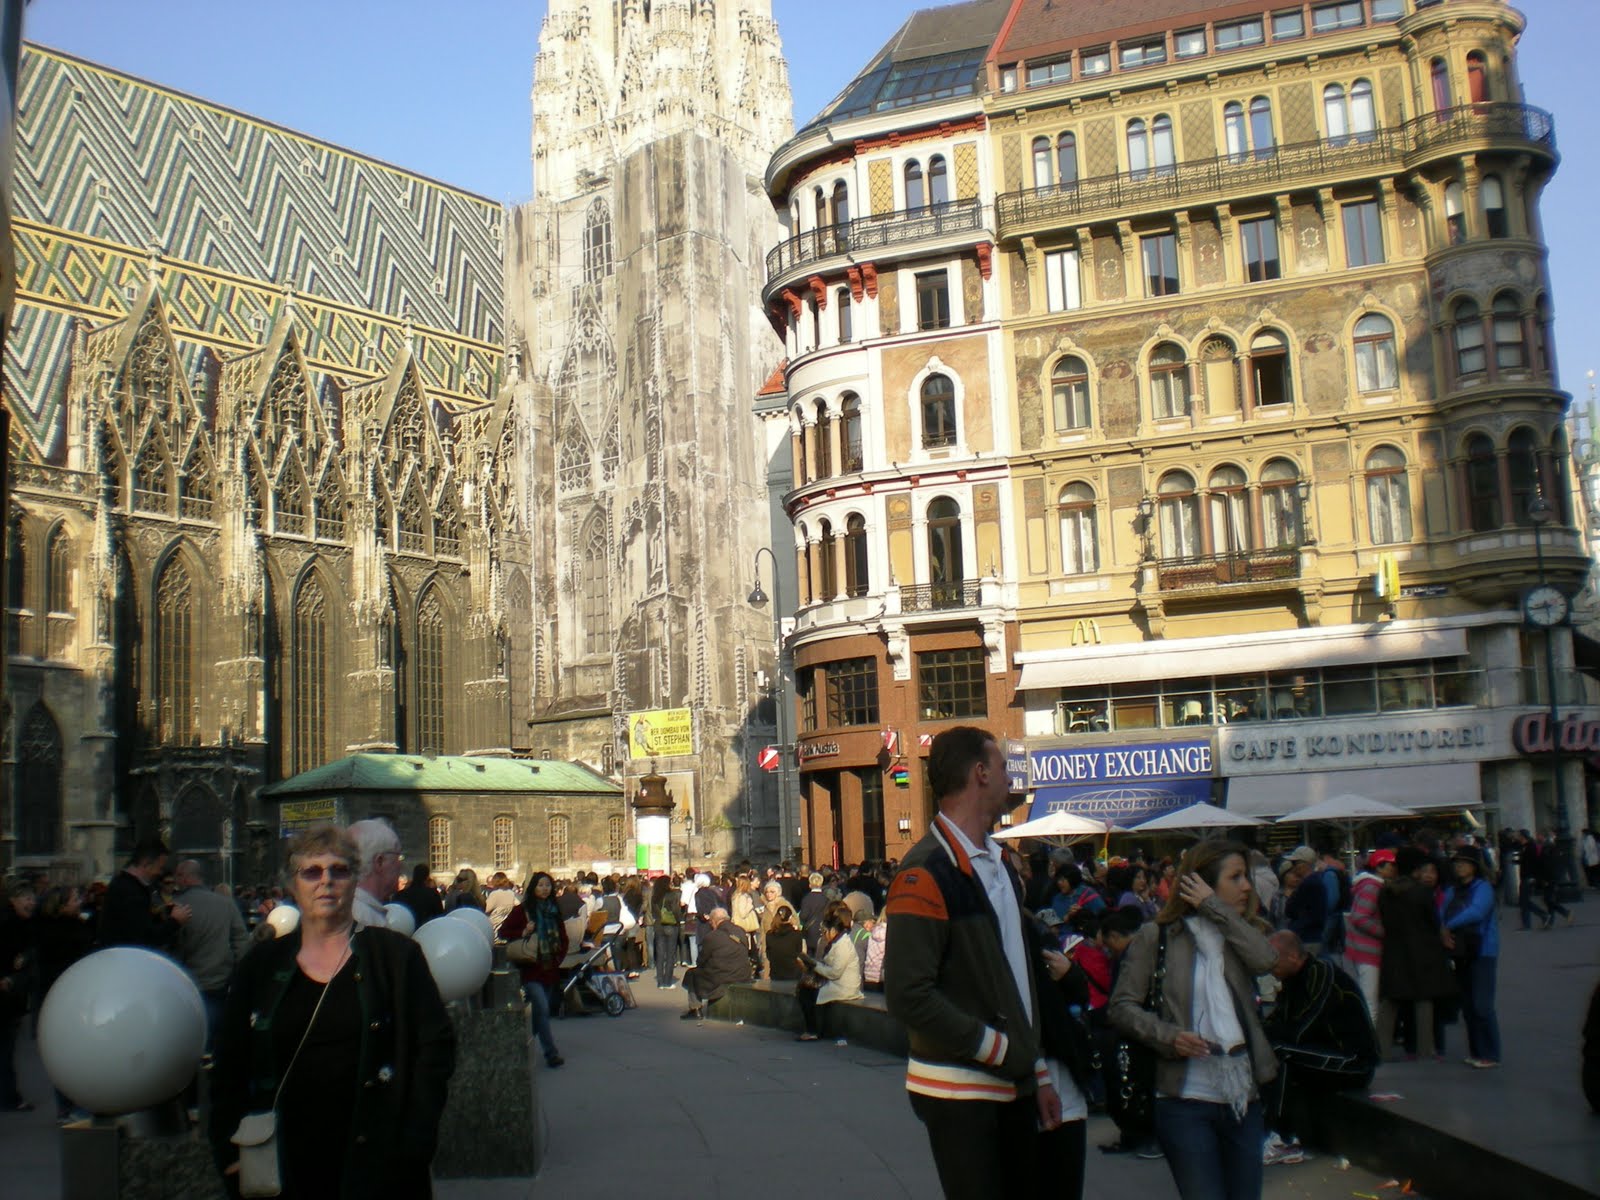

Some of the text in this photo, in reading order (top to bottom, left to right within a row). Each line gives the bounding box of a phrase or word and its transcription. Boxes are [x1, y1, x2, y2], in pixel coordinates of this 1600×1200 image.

[664, 734, 690, 745] STEPHAN
[814, 741, 840, 754] Austria
[1306, 725, 1485, 758] KONDITOREI
[1031, 746, 1213, 782] MONEY EXCHANGE
[1048, 795, 1196, 813] THE CHANGE GROUP
